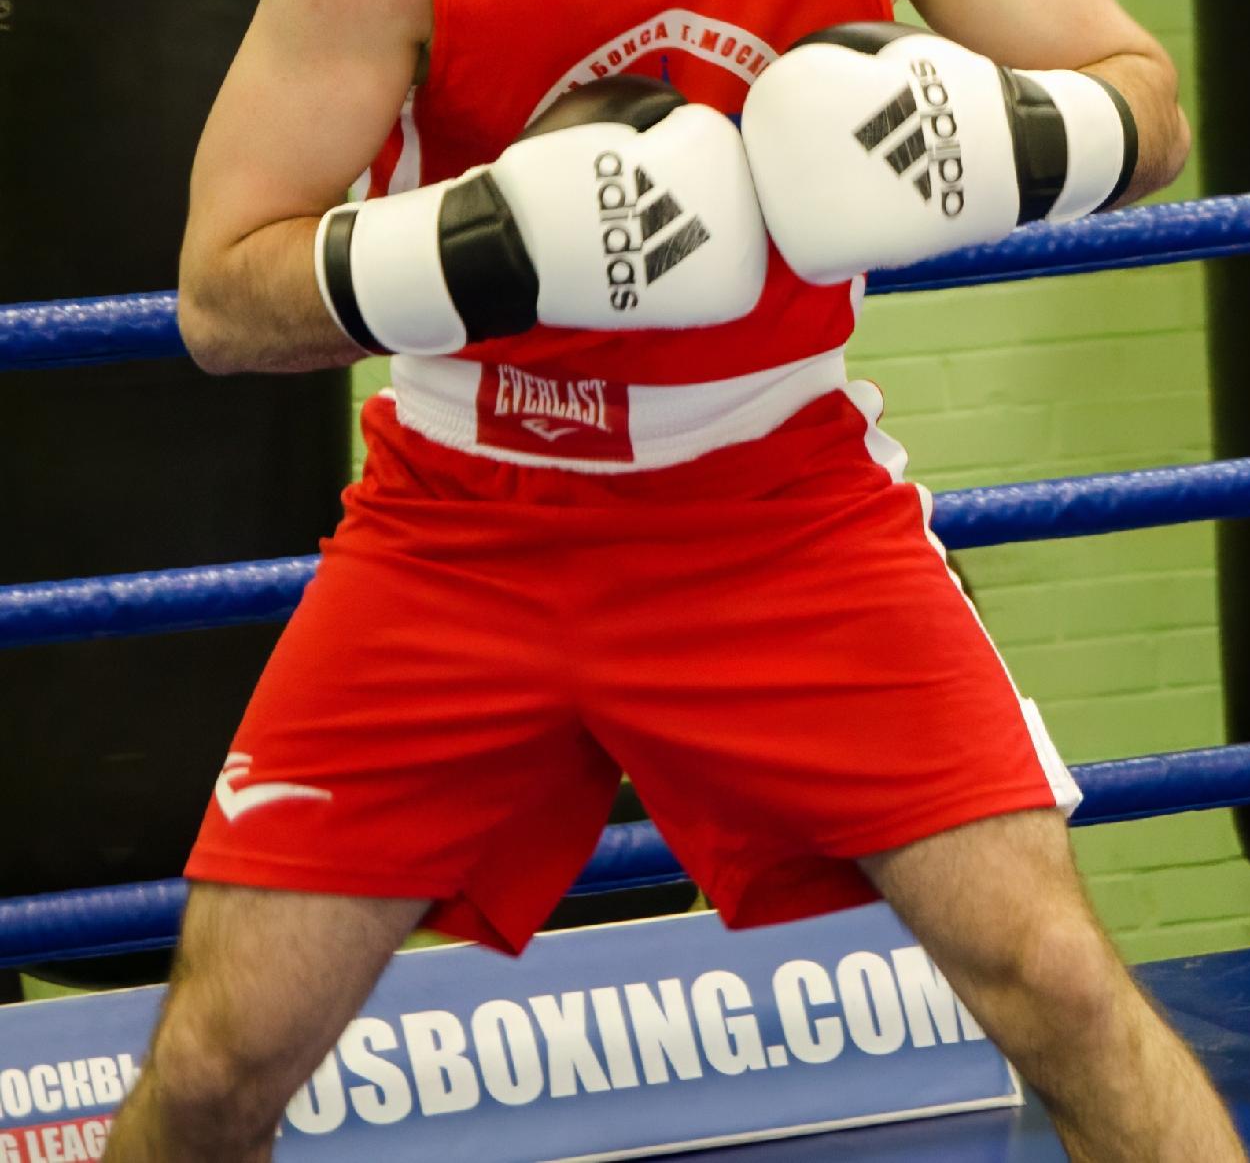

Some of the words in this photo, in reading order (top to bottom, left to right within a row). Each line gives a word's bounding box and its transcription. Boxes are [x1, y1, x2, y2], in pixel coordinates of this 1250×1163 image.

[910, 58, 964, 219] adidas
[595, 149, 639, 311] adidas
[494, 364, 610, 432] EVERLAST
[275, 945, 987, 1137] OSBOXING.COM
[23, 1119, 113, 1163] LEAG
